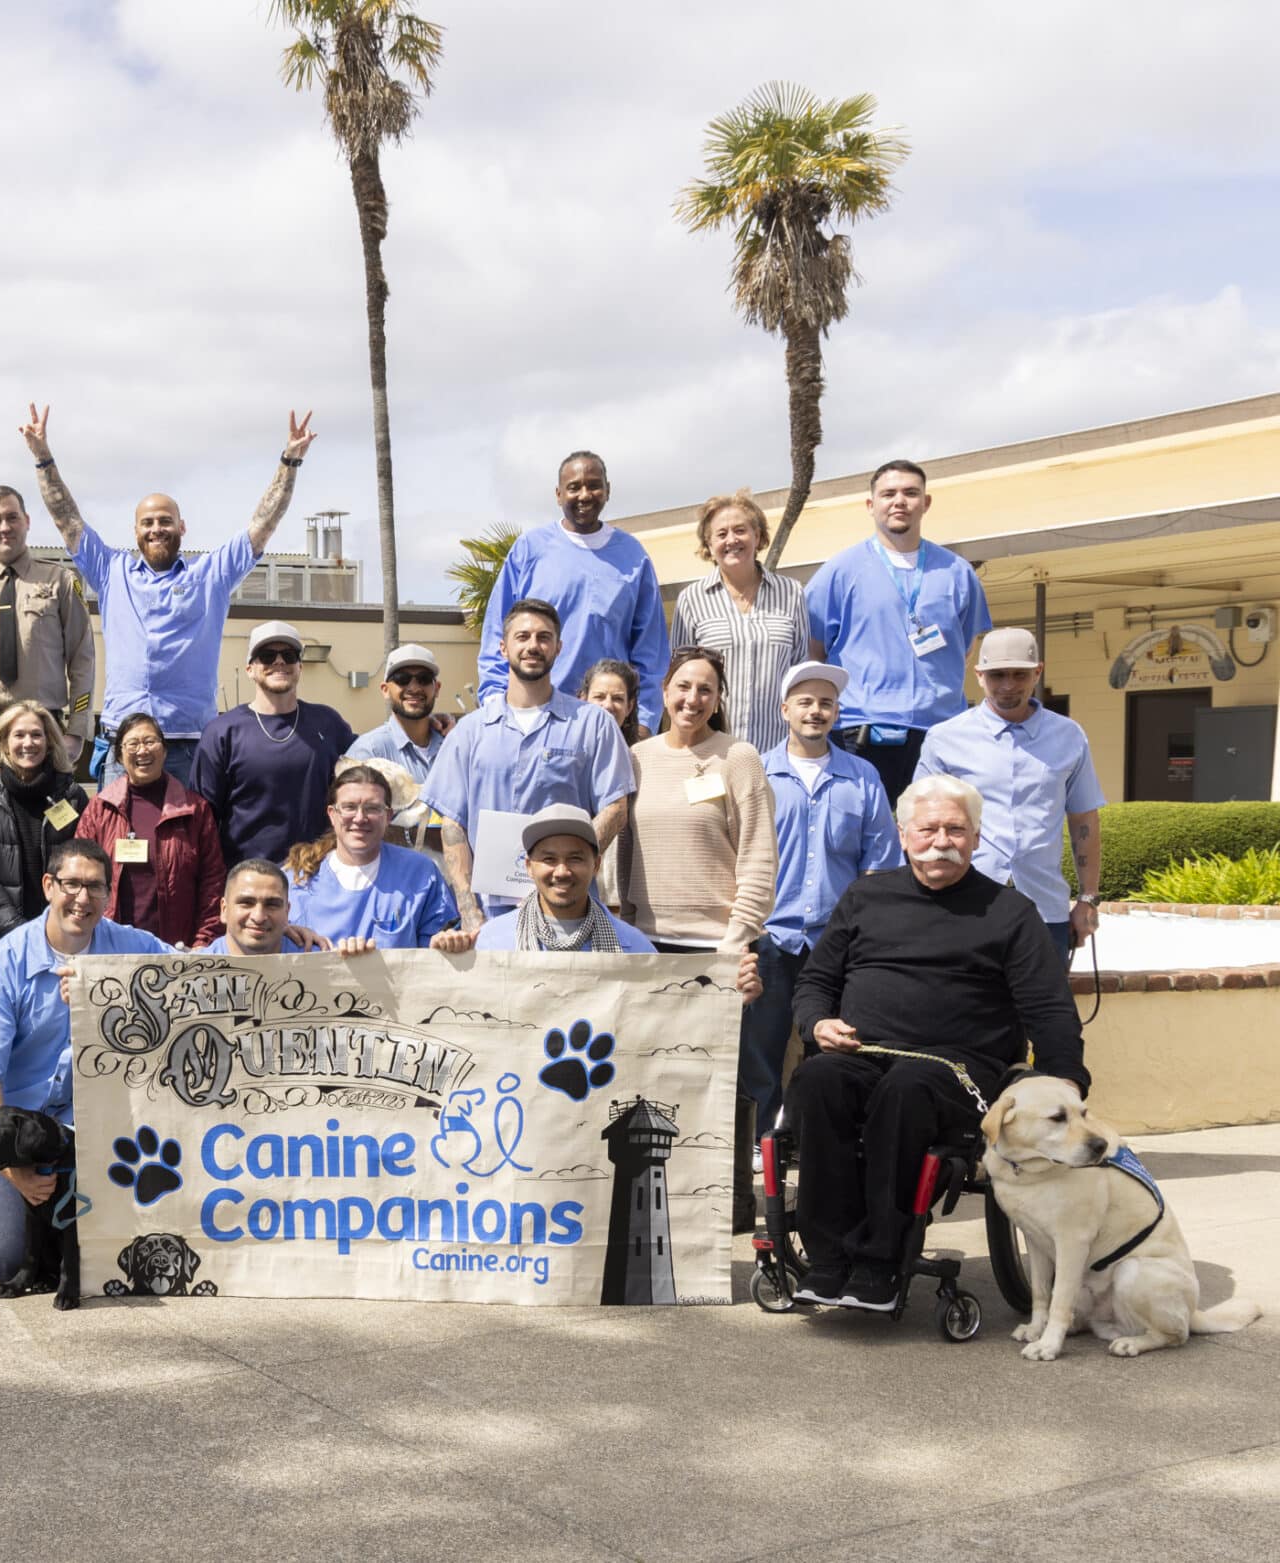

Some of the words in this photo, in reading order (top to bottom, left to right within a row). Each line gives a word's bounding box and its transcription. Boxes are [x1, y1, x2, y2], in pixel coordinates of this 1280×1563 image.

[201, 1118, 416, 1181] Canine
[200, 1182, 584, 1255] Companions
[412, 1247, 549, 1285] Canine.org
